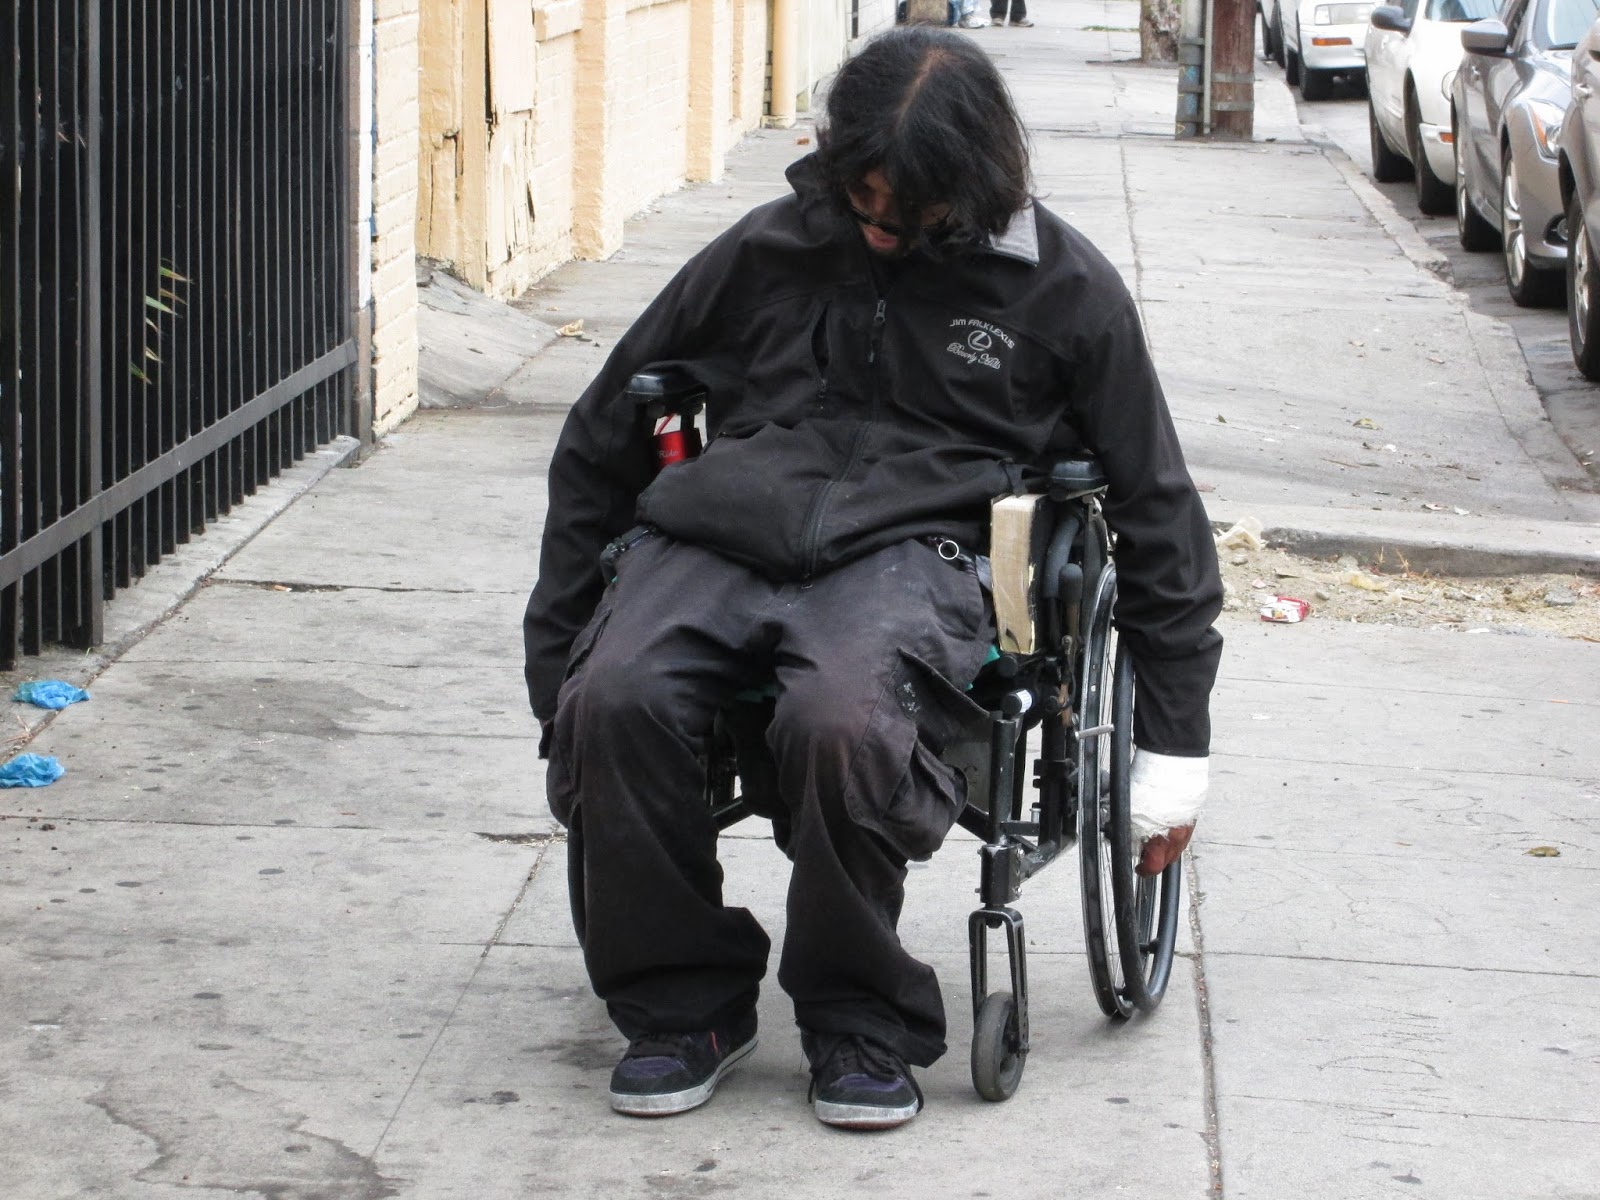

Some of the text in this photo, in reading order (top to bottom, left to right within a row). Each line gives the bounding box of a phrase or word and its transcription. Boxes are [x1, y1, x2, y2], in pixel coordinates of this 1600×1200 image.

[949, 319, 1015, 349] JIM FALK LEXUS
[947, 342, 977, 364] Beverly
